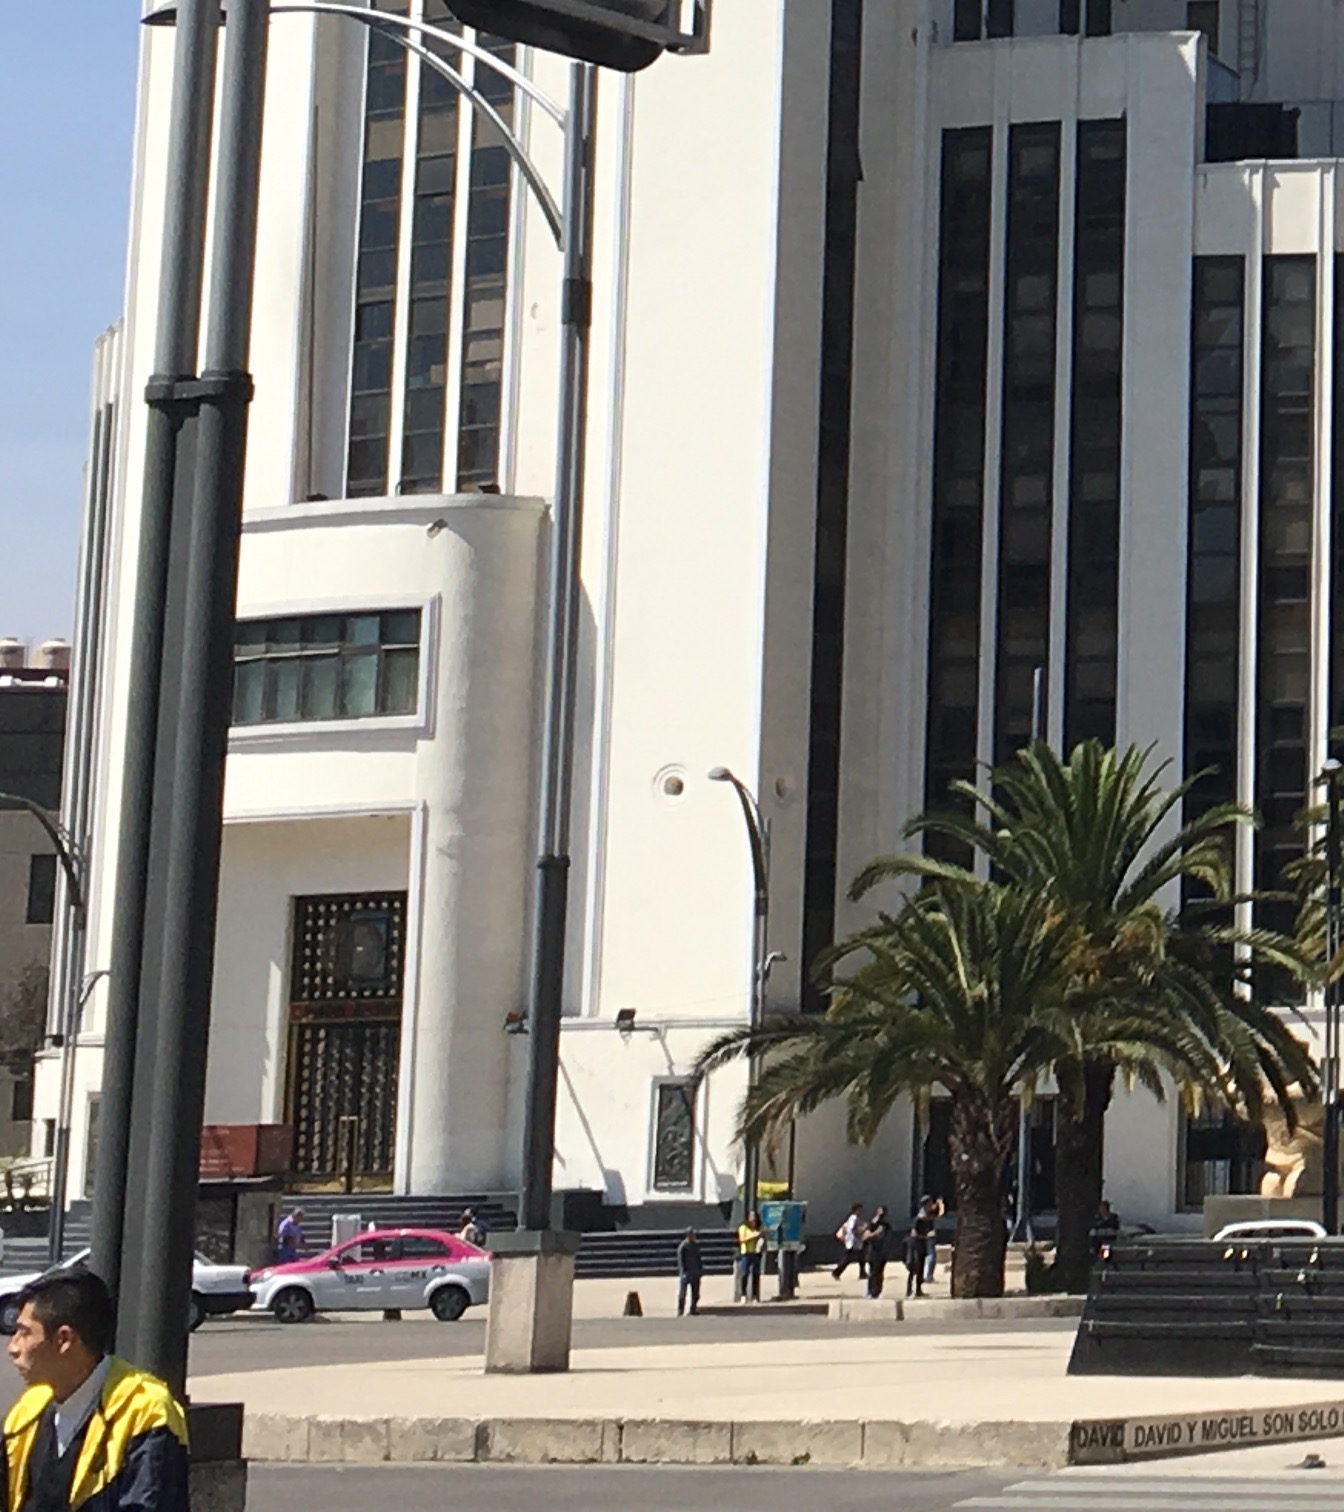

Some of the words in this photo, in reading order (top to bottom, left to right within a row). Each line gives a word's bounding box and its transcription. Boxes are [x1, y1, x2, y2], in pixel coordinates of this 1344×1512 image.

[1076, 1422, 1126, 1448] DAVID
[1134, 1422, 1182, 1448] DAVID
[1186, 1419, 1198, 1443] Y
[1201, 1415, 1258, 1441] MIGUEL
[1262, 1412, 1295, 1436] SON
[1299, 1407, 1339, 1432] SOLO
